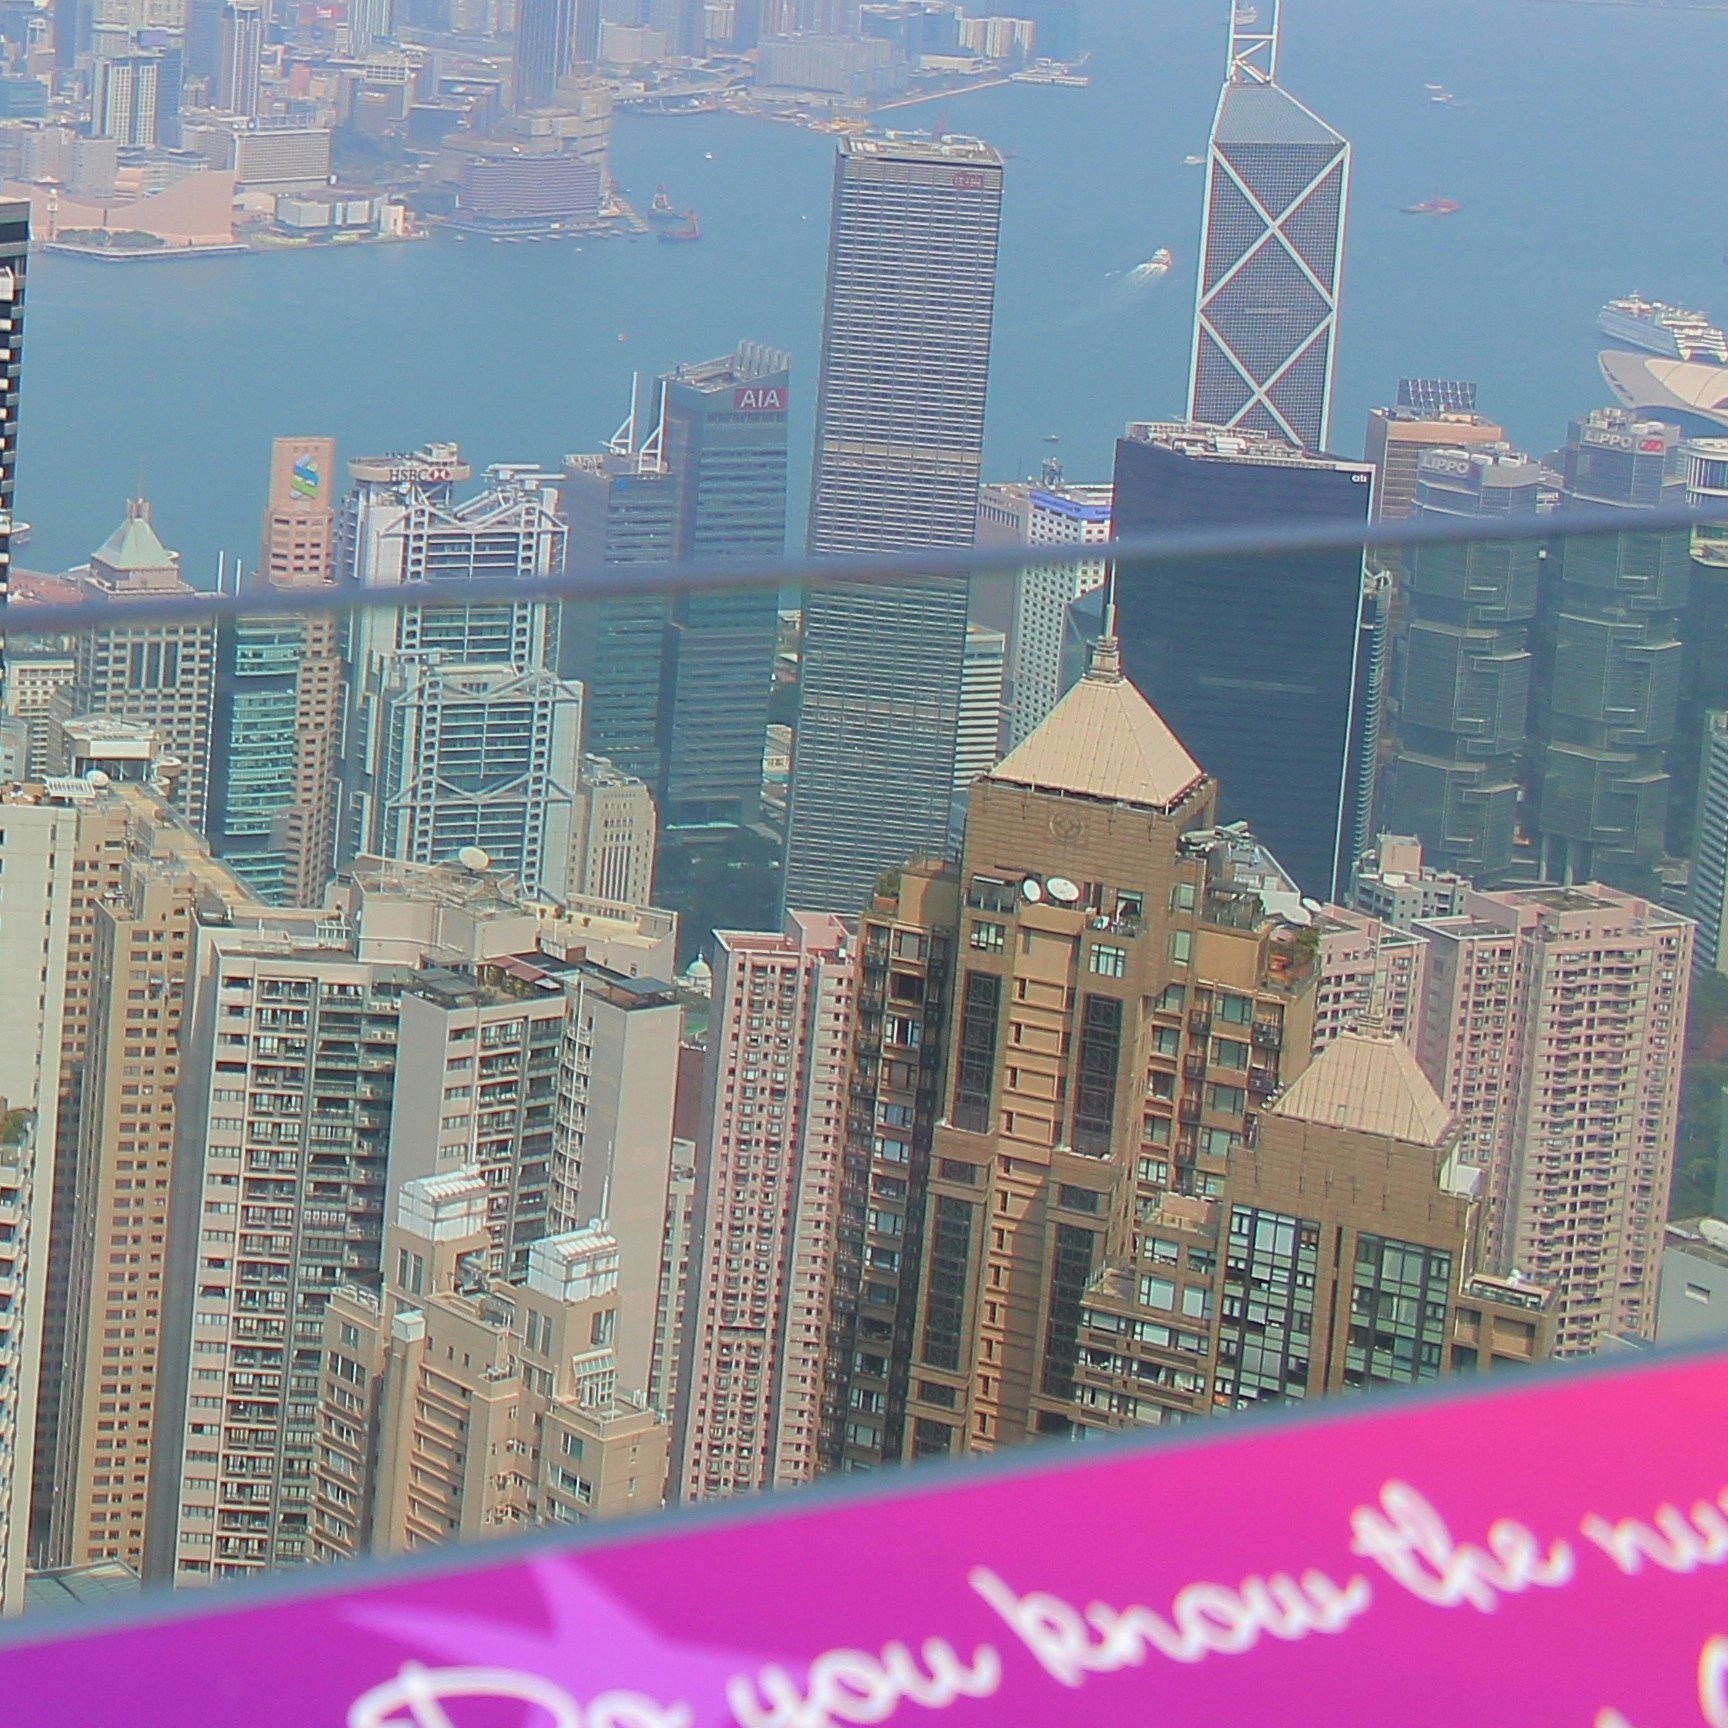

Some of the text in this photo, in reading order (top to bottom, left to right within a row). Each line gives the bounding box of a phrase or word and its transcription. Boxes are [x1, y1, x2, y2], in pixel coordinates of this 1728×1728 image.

[740, 389, 780, 408] AIA
[1584, 431, 1632, 449] LIPPO
[1422, 455, 1469, 475] LIPPO
[389, 468, 429, 482] HSBC
[971, 1569, 1370, 1685] know
[1351, 1482, 1573, 1611] the
[1582, 1492, 1728, 1573] nu
